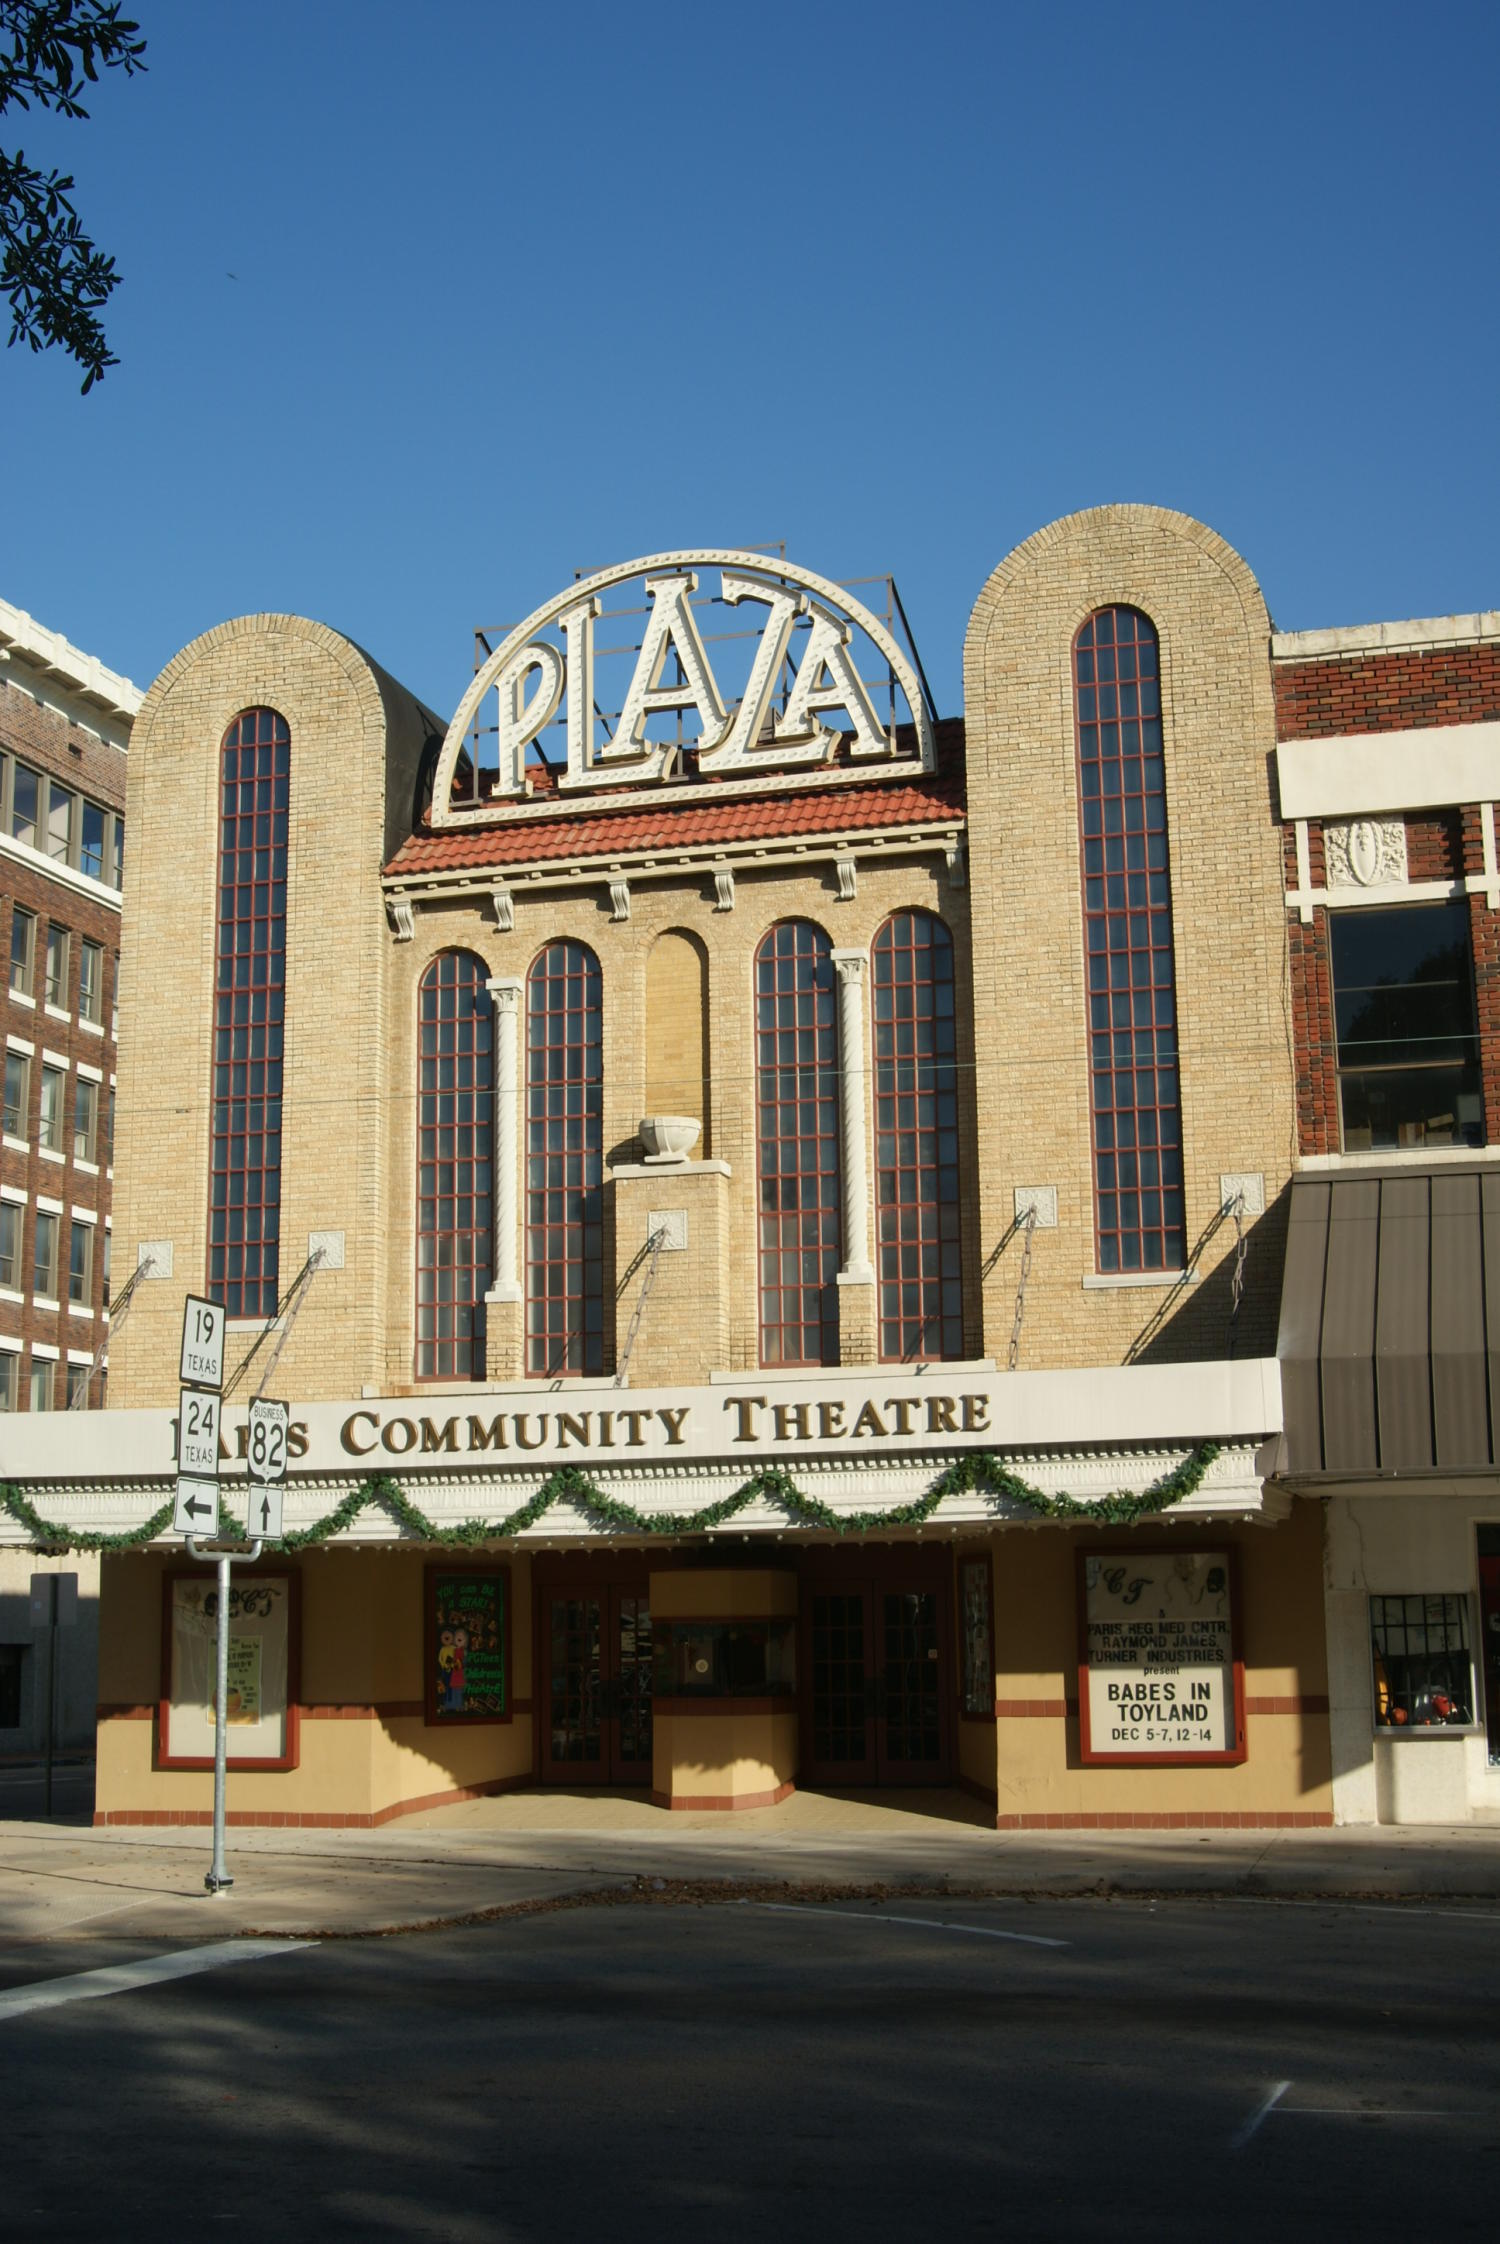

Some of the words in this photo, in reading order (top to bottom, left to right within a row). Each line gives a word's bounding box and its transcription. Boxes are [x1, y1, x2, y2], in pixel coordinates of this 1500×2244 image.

[491, 571, 896, 799] PLAZA
[195, 1308, 215, 1345] 19
[187, 1353, 217, 1376] TEXAS
[187, 1400, 214, 1438] 24
[253, 1404, 284, 1421] BUSINESS
[252, 1420, 284, 1468] 82
[185, 1445, 213, 1465] TEXAS
[1087, 1623, 1122, 1636] PARIS
[1128, 1622, 1154, 1635] REG
[1159, 1622, 1185, 1634] MED
[1102, 1635, 1167, 1649] RAYMOND
[1088, 1650, 1137, 1663] TURNER
[1144, 1665, 1180, 1677] present
[1107, 1682, 1176, 1701] BABES
[1190, 1682, 1211, 1700] IN
[1117, 1703, 1208, 1722] TOYLAND
[1111, 1727, 1140, 1741] DEC
